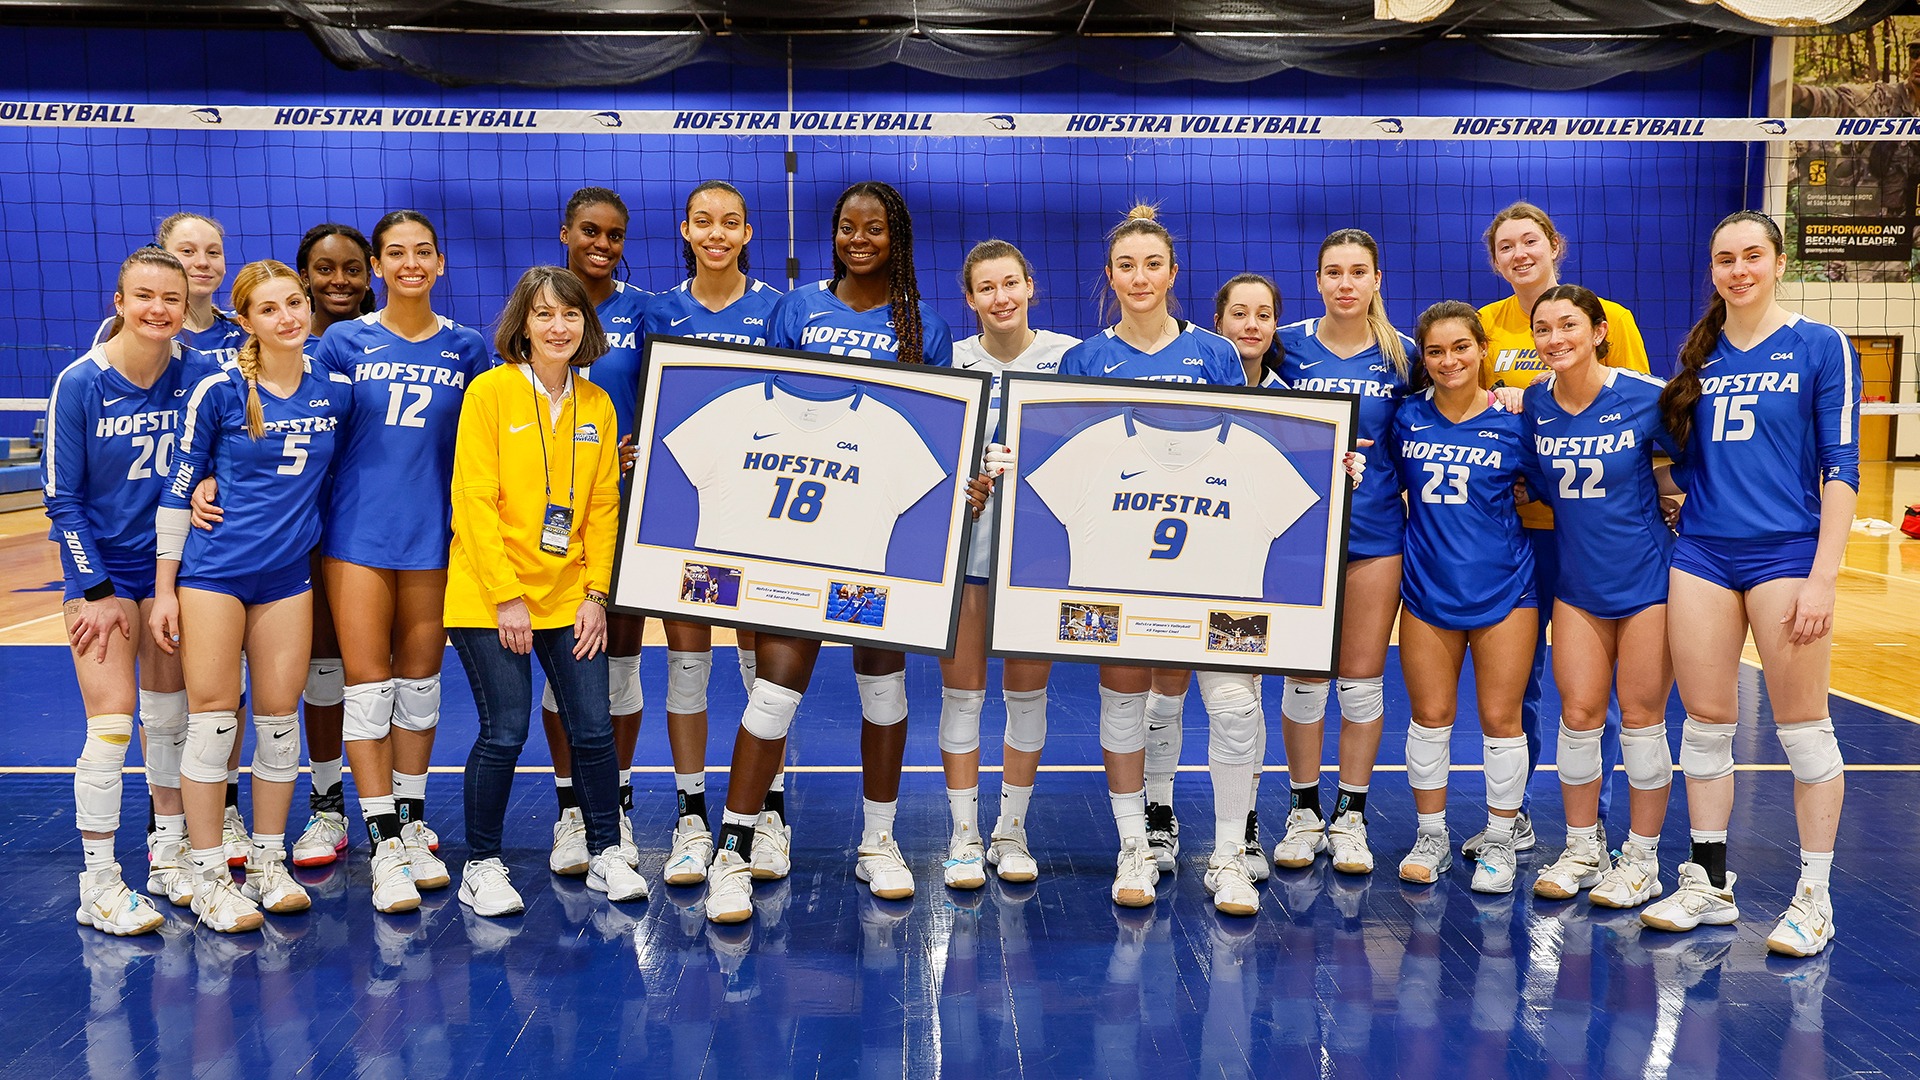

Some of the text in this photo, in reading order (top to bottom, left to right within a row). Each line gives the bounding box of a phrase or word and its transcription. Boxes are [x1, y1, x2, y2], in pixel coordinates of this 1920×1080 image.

[274, 108, 538, 128] HOFSTRA VOLLEYBALL
[673, 111, 933, 131] HOFSTRA VOLLEYBALL
[1066, 114, 1322, 134] HOFSTRA VOLLEYBALL
[1452, 118, 1705, 136] HOFSTRA VOLLEYBALL
[1828, 194, 1841, 202] Long
[1805, 224, 1905, 235] STEP FORWARD AND
[1805, 236, 1897, 247] BECOME A LEADER.
[610, 316, 632, 325] CAA
[742, 317, 764, 326] CAA
[440, 350, 460, 361] CAA
[1182, 357, 1204, 367] CAA
[1494, 348, 1519, 373] H
[1769, 352, 1793, 361] CAA
[355, 362, 465, 390] HOFSTRA
[1368, 364, 1388, 374] CAA
[1514, 361, 1553, 371] VOLLE
[1292, 377, 1394, 398] HOFSTRA
[1699, 372, 1799, 395] OFSTRA
[309, 399, 331, 408] CAA
[385, 382, 433, 428] 12
[241, 416, 338, 434] OFSTRA
[1599, 412, 1622, 424] CAA
[1711, 394, 1759, 442] 15
[1478, 430, 1499, 440] CAA
[127, 432, 175, 480] 20
[276, 433, 311, 476] 5
[836, 441, 859, 453] CAA
[1401, 440, 1502, 469] HOFSTRA
[742, 451, 860, 485] HOFSTRA
[171, 461, 195, 499] PRIDE
[1205, 476, 1228, 487] CAA
[1421, 462, 1471, 505] 23
[1552, 458, 1606, 499] 22
[767, 476, 827, 524] 18
[1112, 492, 1231, 520] HOFSTRA
[1147, 516, 1189, 561] 9
[63, 530, 94, 574] PRIDE
